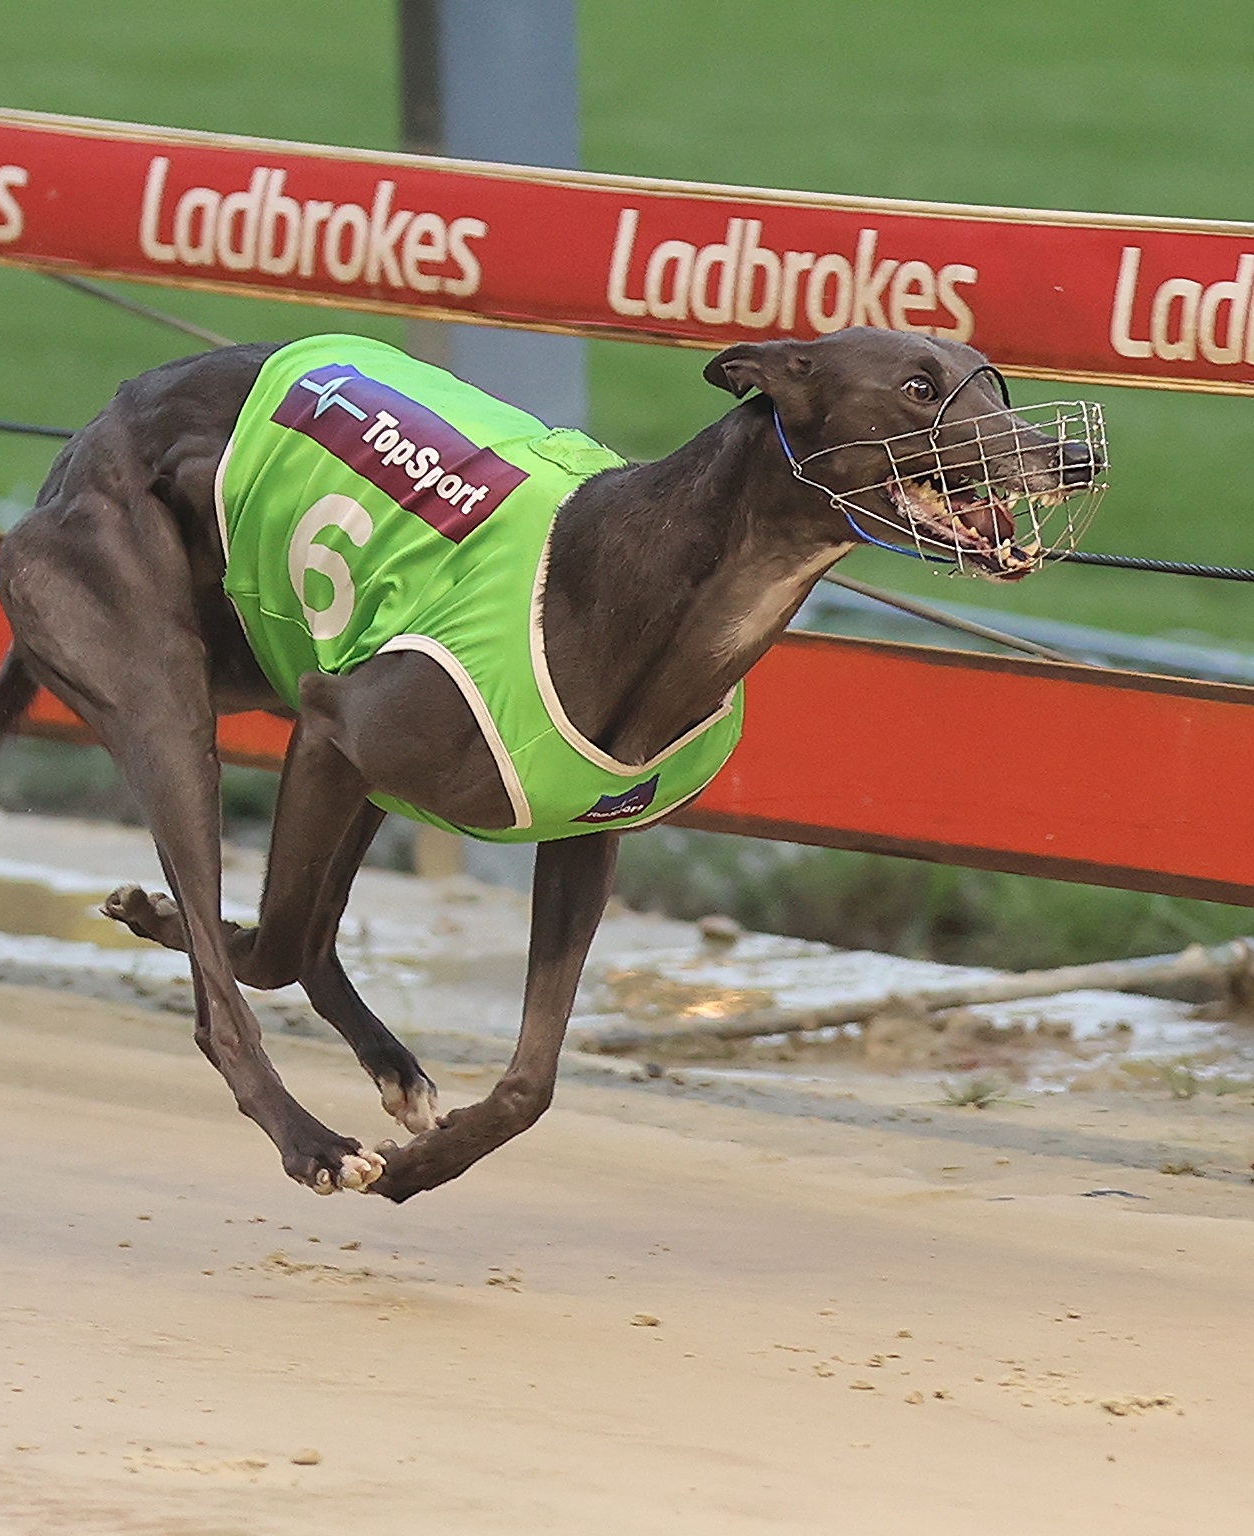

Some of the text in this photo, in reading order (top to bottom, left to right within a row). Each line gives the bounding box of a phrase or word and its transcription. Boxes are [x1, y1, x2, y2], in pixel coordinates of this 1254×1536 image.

[139, 156, 489, 297] Ladbrokes
[607, 207, 979, 343] Ladbrokes
[1110, 245, 1254, 365] Lad
[361, 410, 489, 515] TopSport
[287, 493, 374, 640] 6
